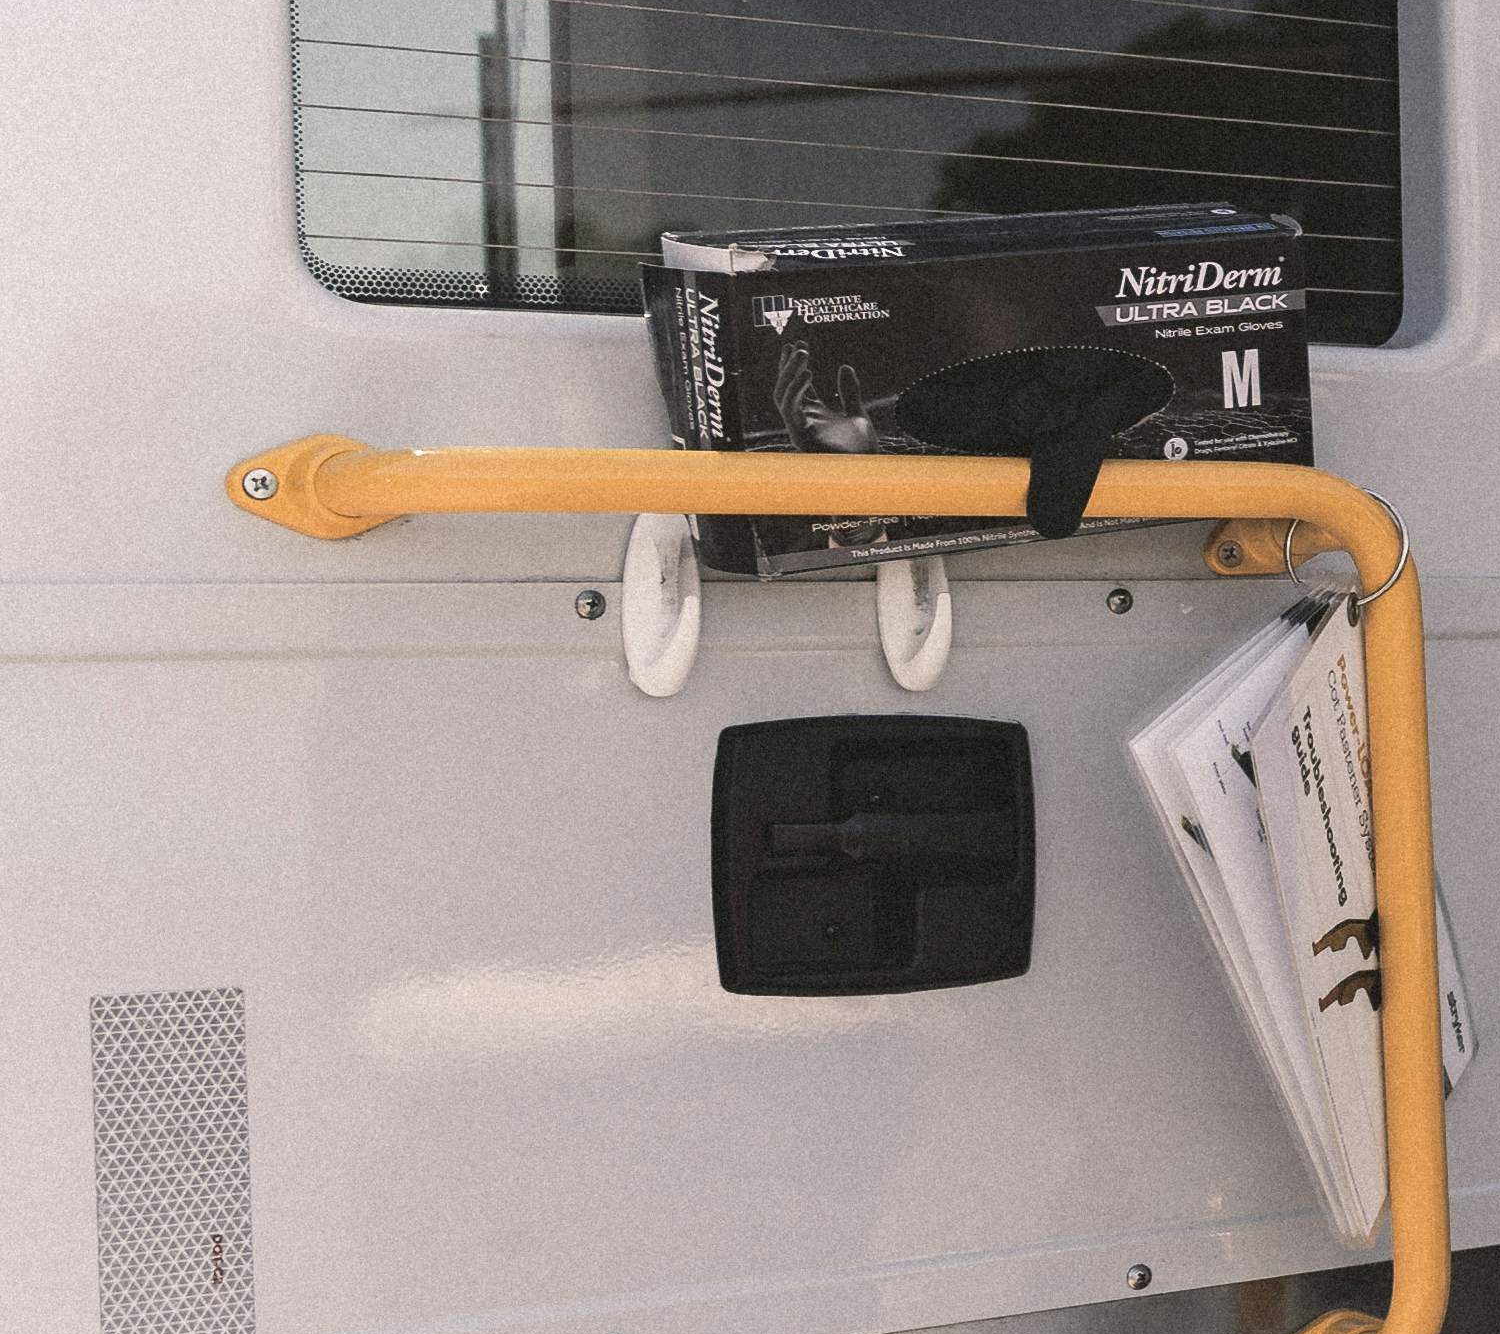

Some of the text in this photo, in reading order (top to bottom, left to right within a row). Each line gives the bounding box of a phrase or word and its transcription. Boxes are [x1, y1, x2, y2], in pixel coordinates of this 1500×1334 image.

[788, 295, 862, 308] INNOVATIVE
[797, 301, 878, 316] HEALTHCARE
[1115, 261, 1283, 298] NitriDerm
[1116, 294, 1289, 322] ULTRA BLACK
[804, 309, 890, 324] CORPORATION
[1155, 321, 1284, 339] Nitrile Exam Gloves
[674, 287, 696, 430] Nitrile Exam Gloves
[686, 287, 709, 440] ULTRA BLACK
[698, 291, 725, 438] NitriDerm
[1222, 348, 1261, 408] M
[811, 516, 899, 532] Powder-Free
[851, 550, 869, 558] This
[870, 545, 903, 556] Product
[912, 541, 934, 550] Made
[935, 539, 956, 548] From
[958, 534, 981, 545] 100%
[982, 531, 1007, 542] Nitrile
[1008, 529, 1040, 539] Synthe
[1336, 654, 1373, 803] Power-LOA
[1291, 724, 1312, 796] guide
[1327, 668, 1377, 875] Cot Fastener Syste
[1302, 706, 1349, 907] Troubleshooting
[1447, 991, 1465, 1054] stryker
